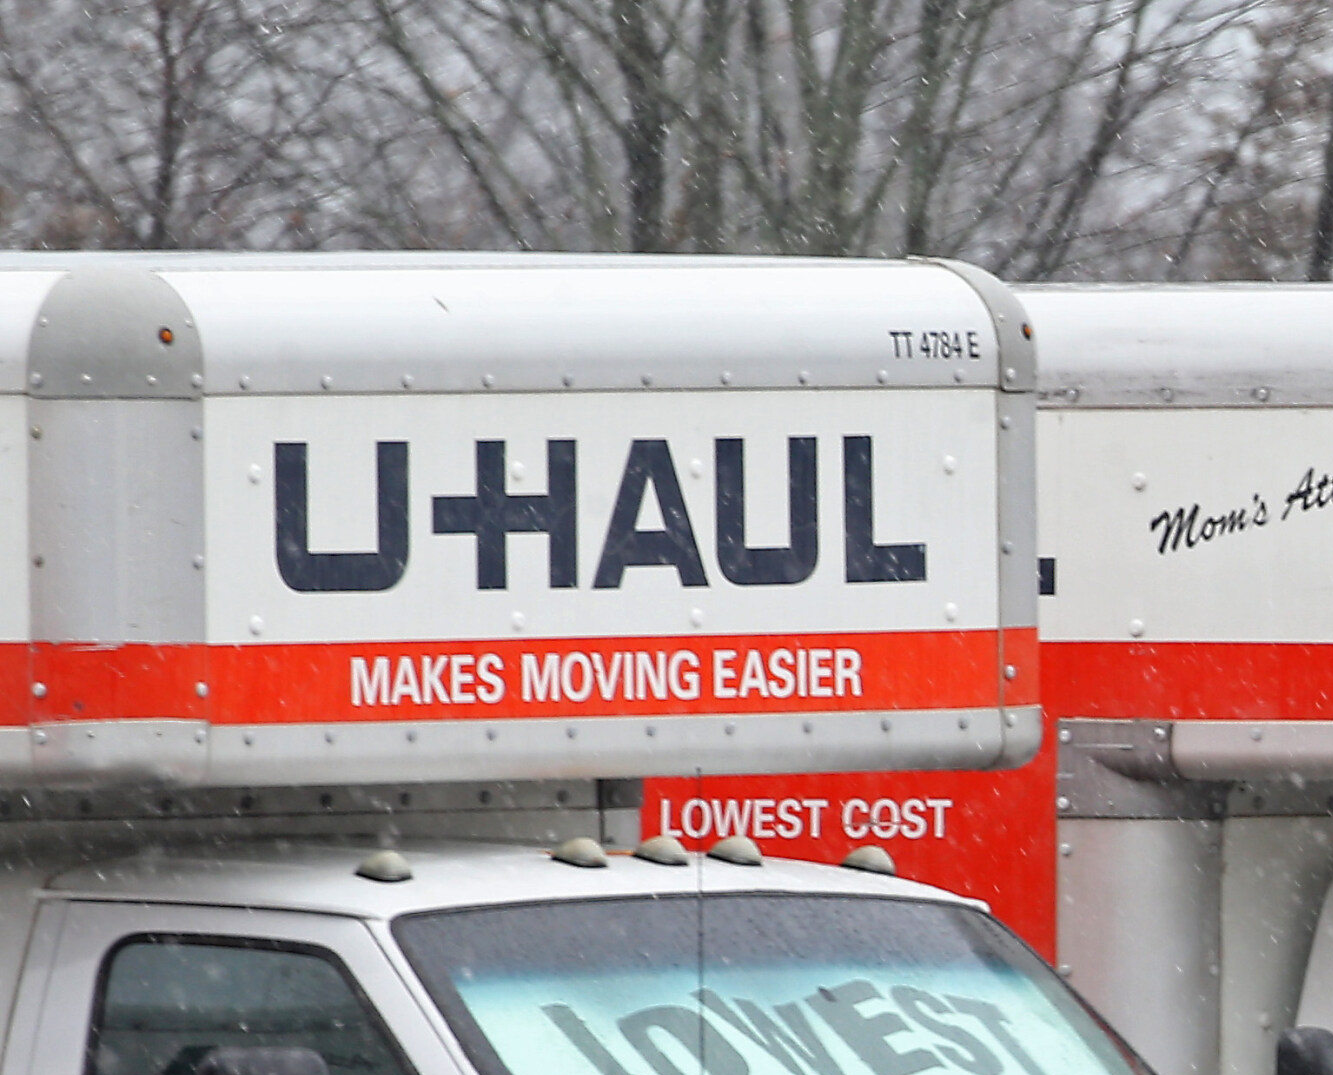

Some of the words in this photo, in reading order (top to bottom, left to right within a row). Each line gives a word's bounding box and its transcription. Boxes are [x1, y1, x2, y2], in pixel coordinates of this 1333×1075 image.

[888, 331, 913, 358] TT
[920, 331, 962, 358] 4784
[967, 331, 980, 358] E
[273, 434, 928, 594] U-HAUL
[1150, 493, 1269, 554] Mom's
[351, 654, 504, 706] MAKES
[521, 650, 701, 702] MOVING
[714, 648, 864, 698] EASIER
[660, 798, 829, 839] LOWEST
[841, 798, 953, 839] COST
